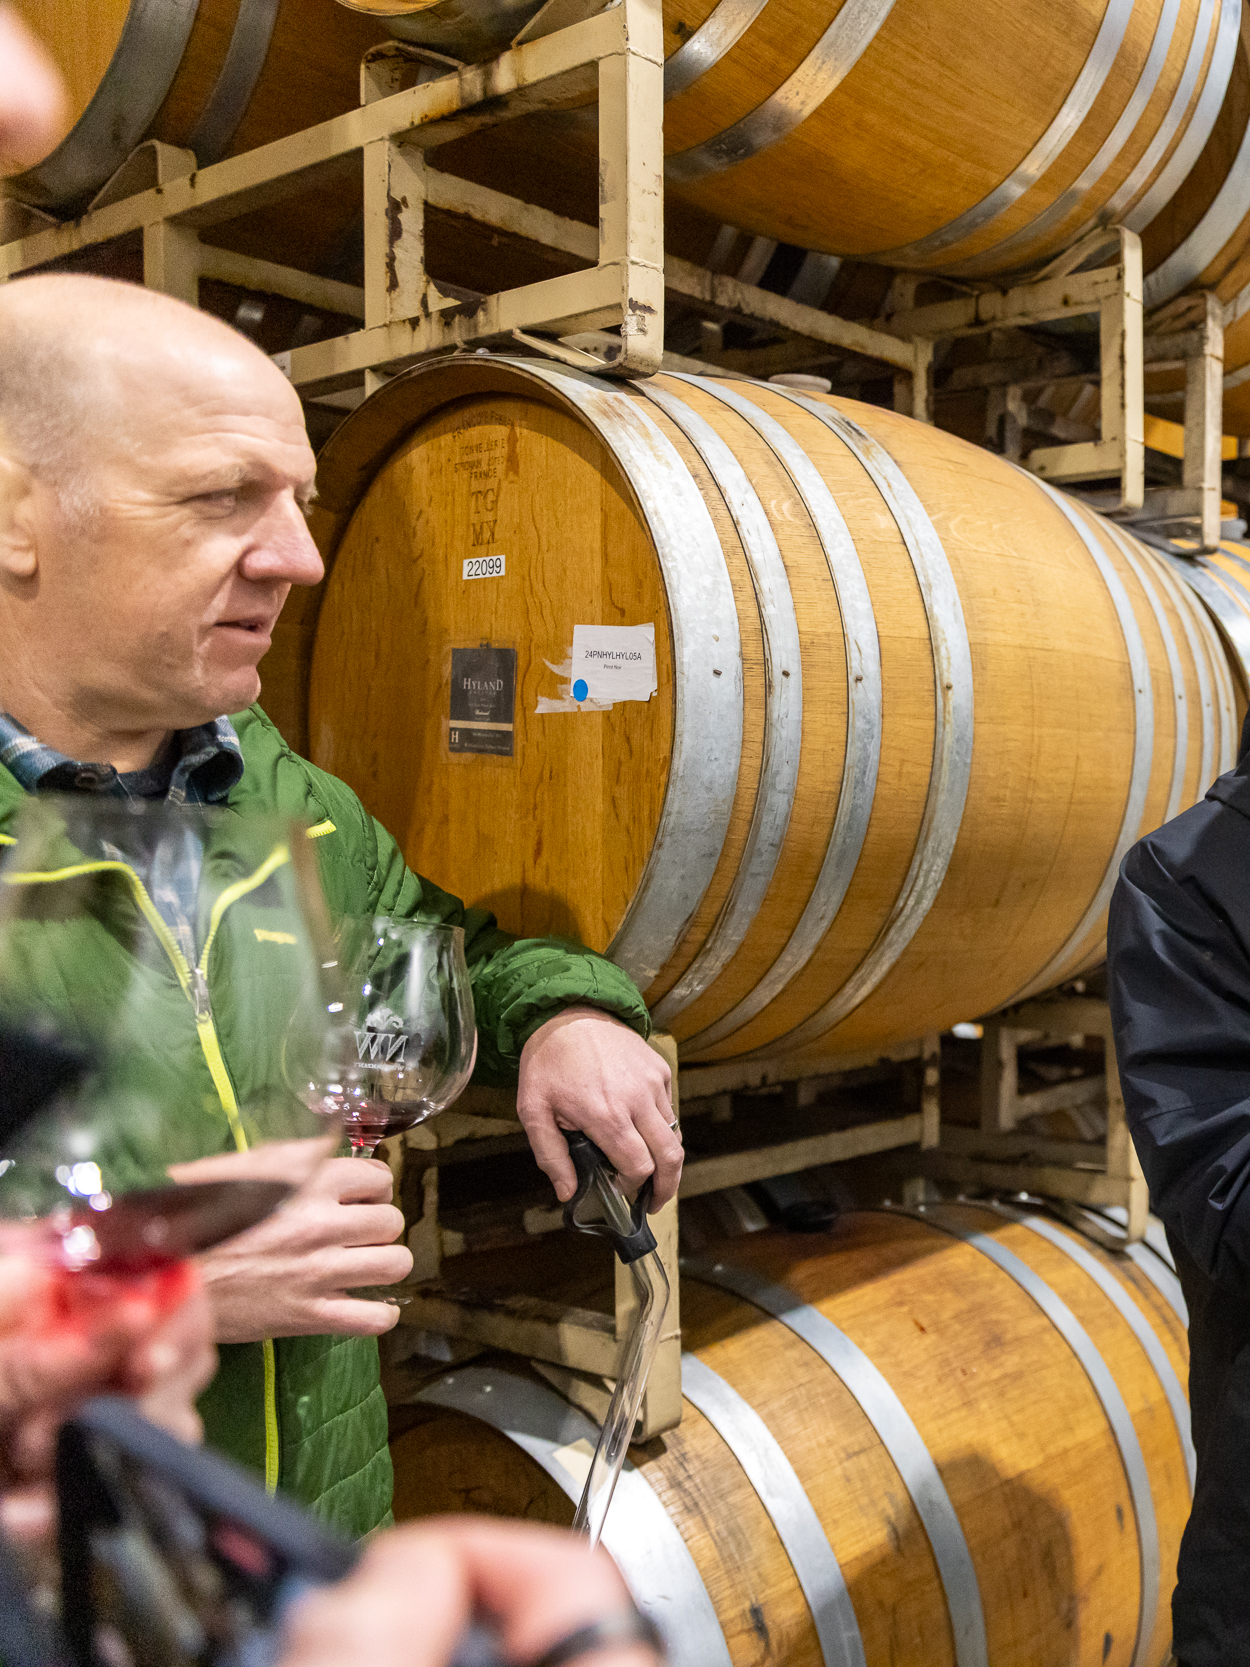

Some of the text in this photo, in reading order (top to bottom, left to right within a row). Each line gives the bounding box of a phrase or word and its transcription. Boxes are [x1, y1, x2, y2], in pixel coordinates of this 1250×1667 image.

[469, 466, 497, 479] FRANCE
[467, 557, 502, 577] 22099
[584, 650, 642, 661] 24PNHYLHYL05A
[451, 731, 459, 743] H
